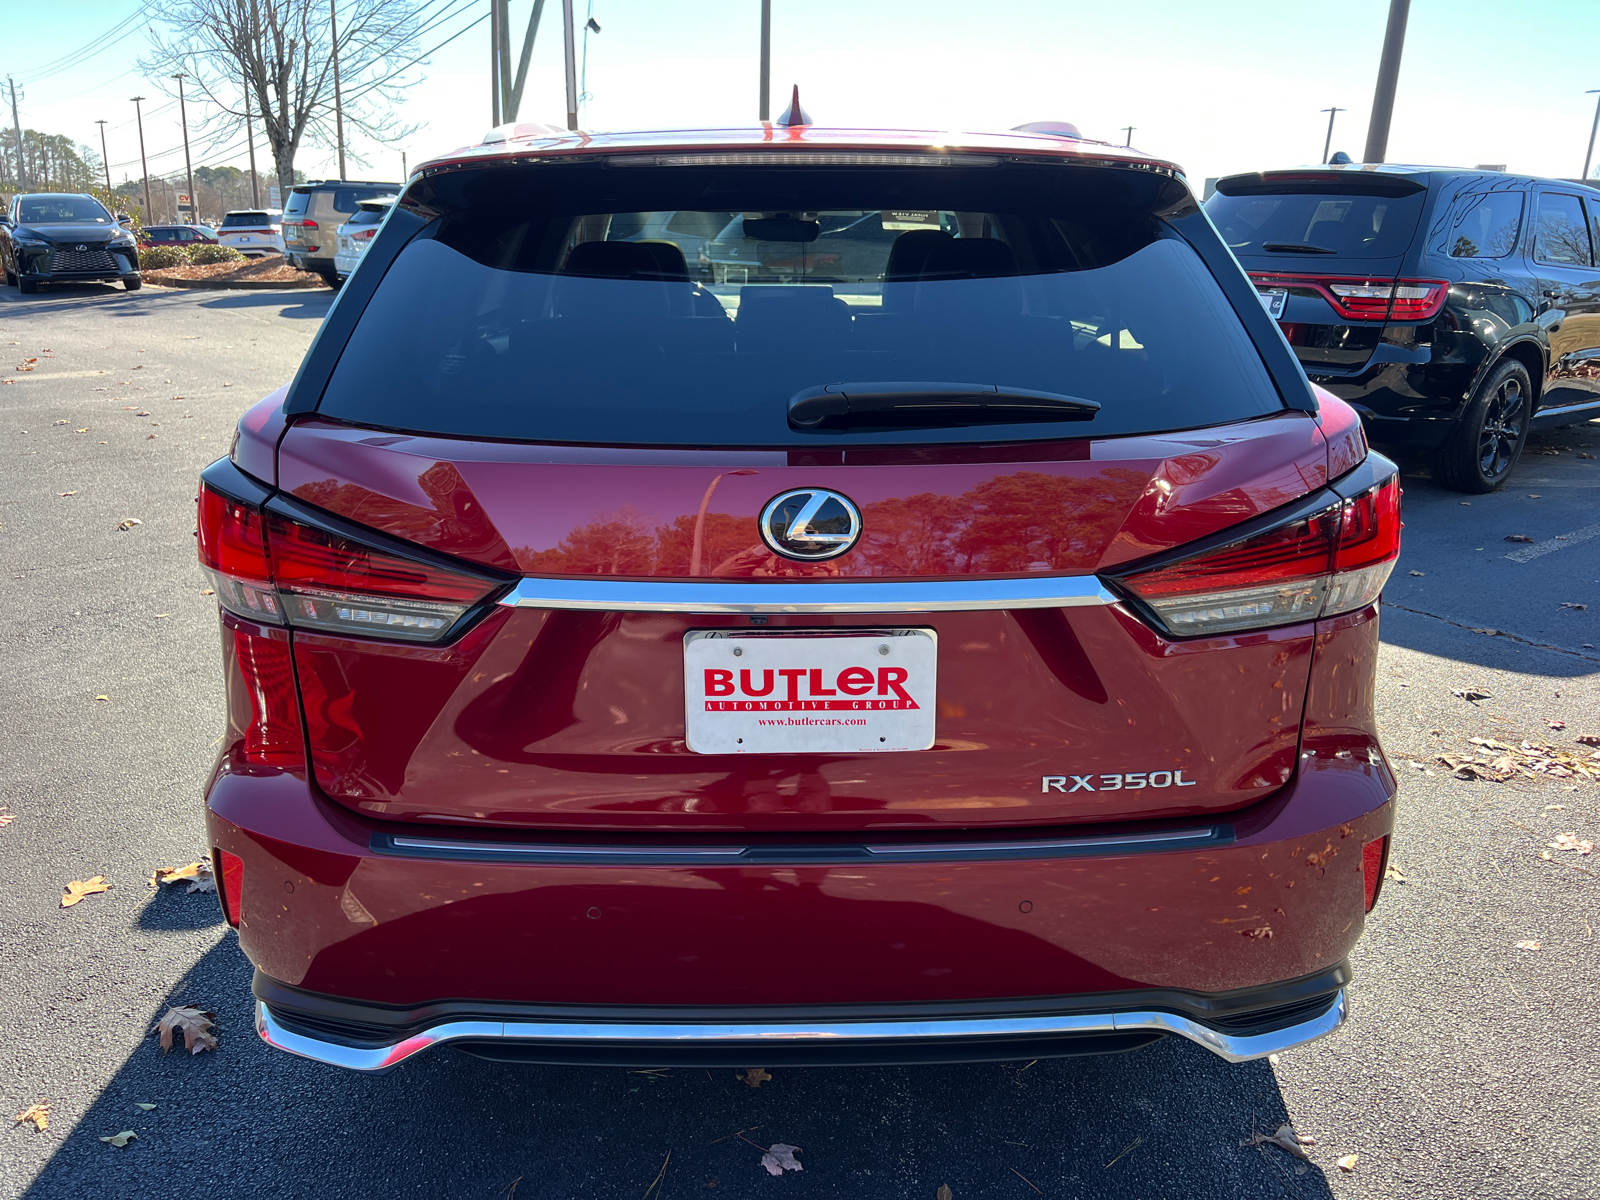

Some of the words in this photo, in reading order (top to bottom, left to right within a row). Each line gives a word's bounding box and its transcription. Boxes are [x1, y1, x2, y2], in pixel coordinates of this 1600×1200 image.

[706, 701, 831, 710] AUTOMOTIVE
[852, 700, 914, 709] GROUP
[758, 716, 867, 727] www.butlercars.com
